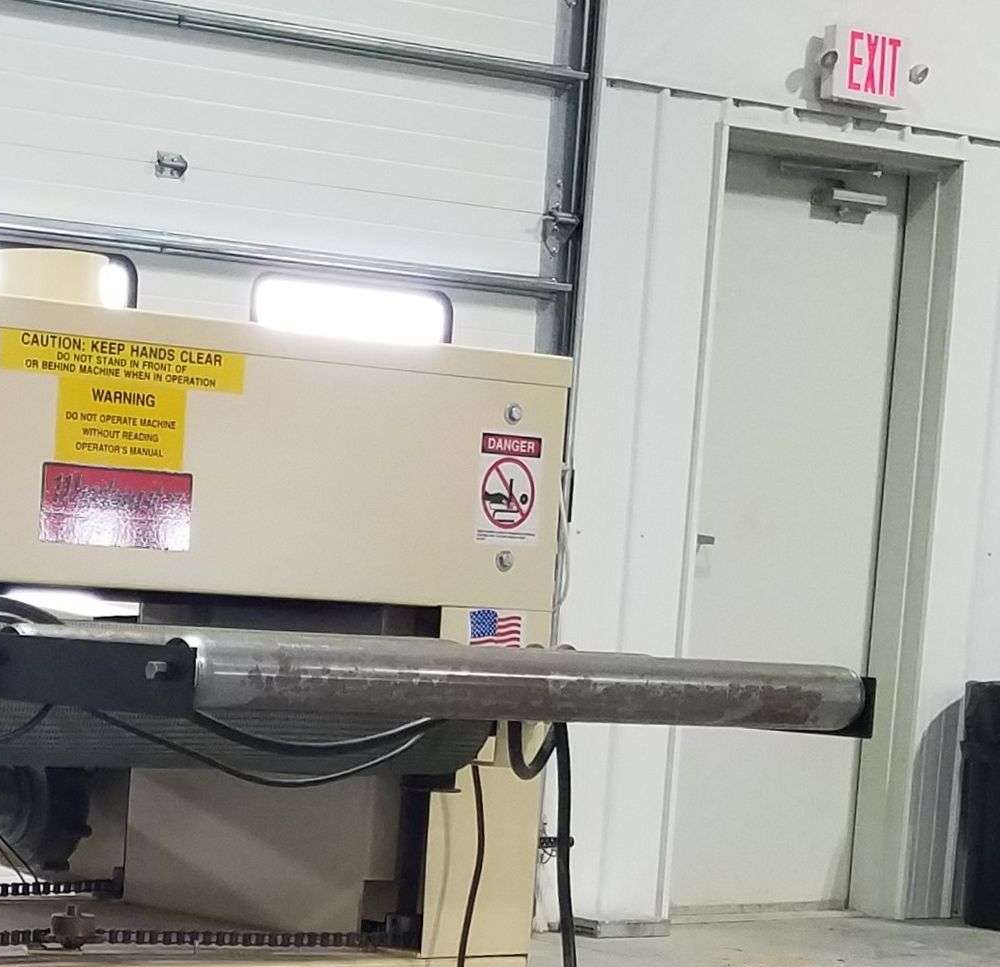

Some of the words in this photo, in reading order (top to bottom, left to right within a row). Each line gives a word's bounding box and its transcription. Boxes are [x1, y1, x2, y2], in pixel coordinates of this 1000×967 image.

[848, 30, 902, 97] EXIT
[21, 332, 85, 352] CAUTION:
[91, 340, 125, 355] KEEP
[131, 345, 175, 361] HANDS
[180, 350, 223, 367] CLEAR
[57, 351, 70, 361] DO
[73, 353, 92, 363] NOT
[96, 356, 127, 368] STAND
[130, 359, 139, 369] IN
[142, 360, 172, 373] FRONT
[175, 364, 187, 374] OF
[25, 359, 39, 369] OR
[42, 360, 76, 373] BEHIND
[79, 364, 121, 377] MACHINE
[123, 370, 150, 381] WHEN
[153, 373, 162, 382] IN
[165, 374, 216, 388] OPERATION
[92, 388, 155, 407] WARNING
[65, 411, 79, 420] DO
[80, 412, 97, 422] NOT
[100, 414, 138, 426] OPERATE
[140, 418, 176, 430] MACHINE
[82, 428, 120, 439] WITHOUT
[122, 431, 159, 443] READING
[487, 437, 536, 453] DANGER
[75, 441, 128, 455] OPERATOR'S
[130, 447, 164, 458] MANUAL
